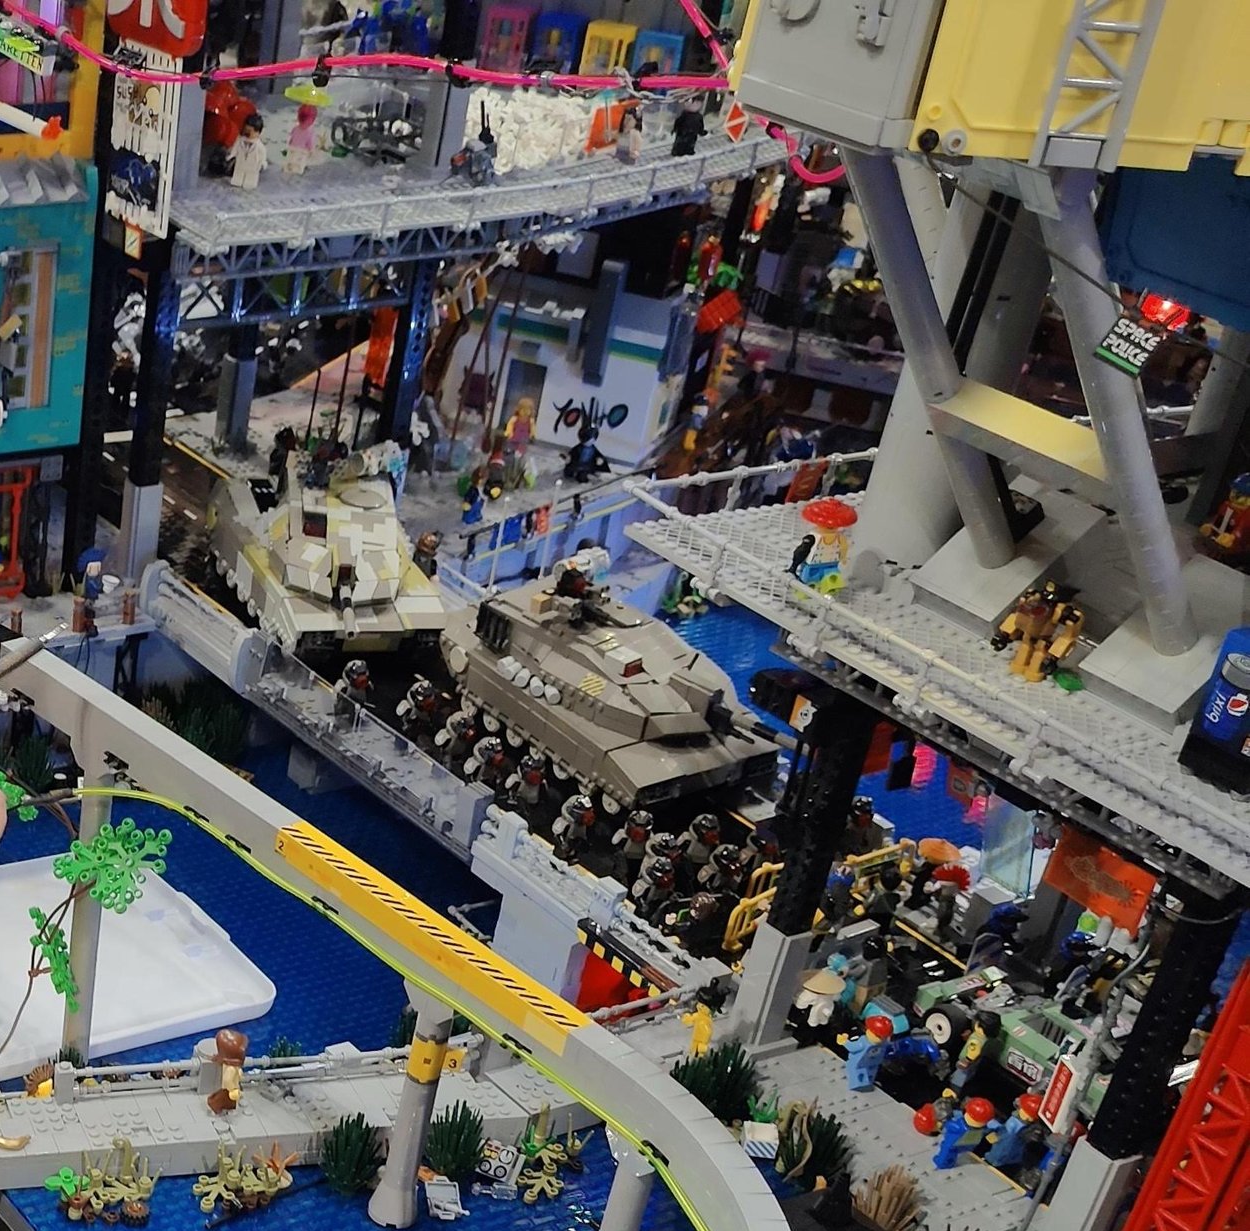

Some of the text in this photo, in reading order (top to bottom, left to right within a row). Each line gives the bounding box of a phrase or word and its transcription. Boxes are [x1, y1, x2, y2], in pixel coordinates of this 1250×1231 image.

[1102, 333, 1149, 367] POLICE
[1113, 318, 1161, 351] SPACE
[448, 1058, 458, 1069] 3
